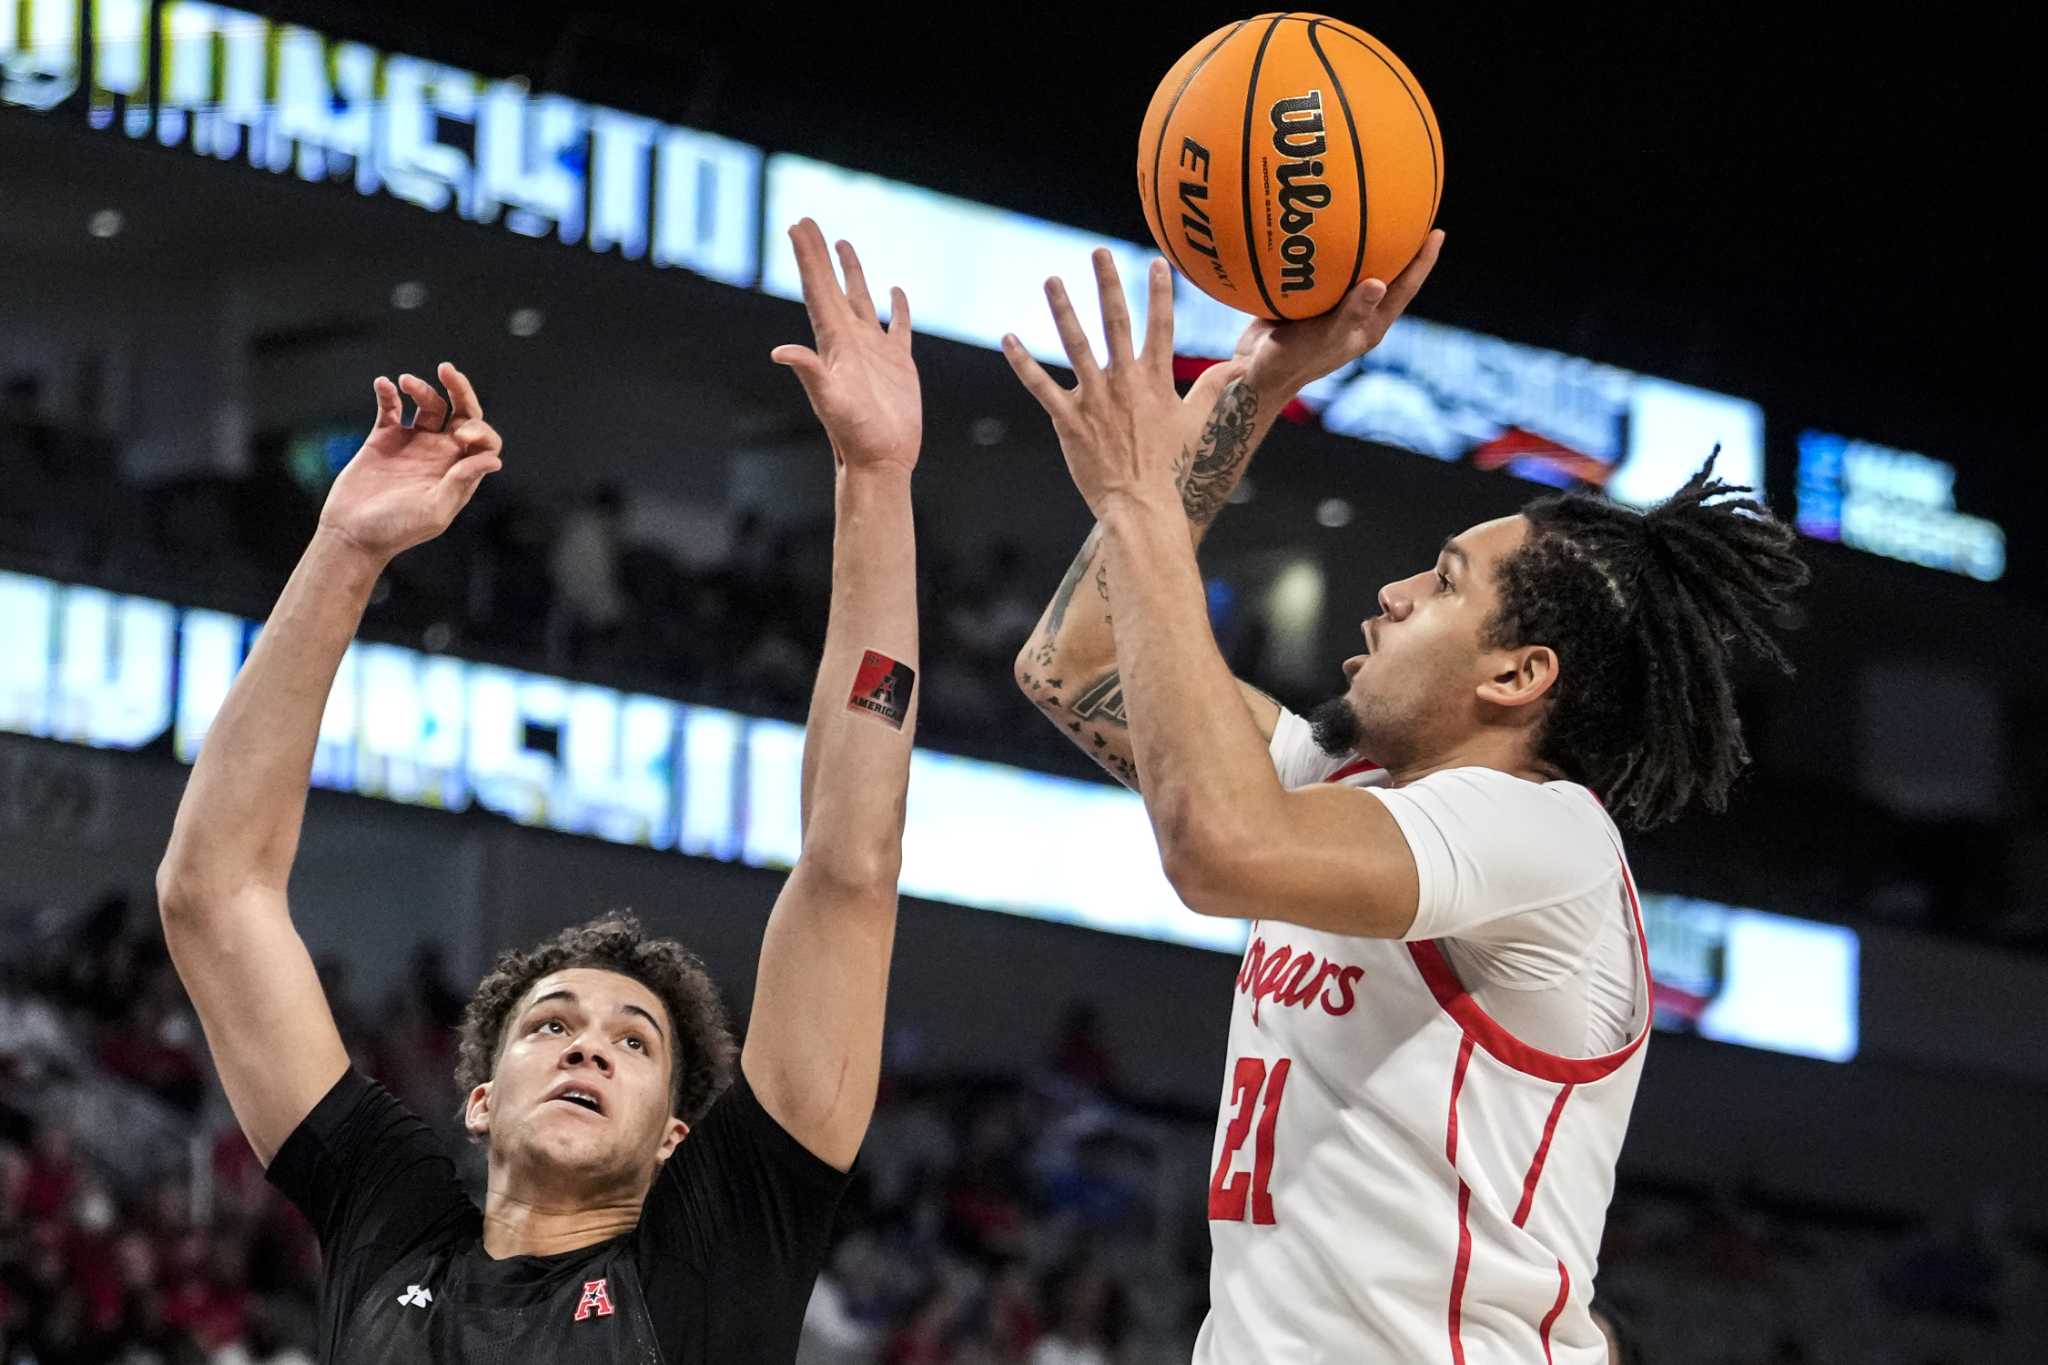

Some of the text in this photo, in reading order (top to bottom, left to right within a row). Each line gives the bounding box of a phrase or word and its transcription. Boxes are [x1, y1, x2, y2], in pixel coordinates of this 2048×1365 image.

[1179, 136, 1218, 258] EVO
[1269, 89, 1332, 293] Wilson
[849, 696, 898, 719] AMERICA
[1207, 1057, 1292, 1226] 21
[574, 1279, 615, 1321] A
